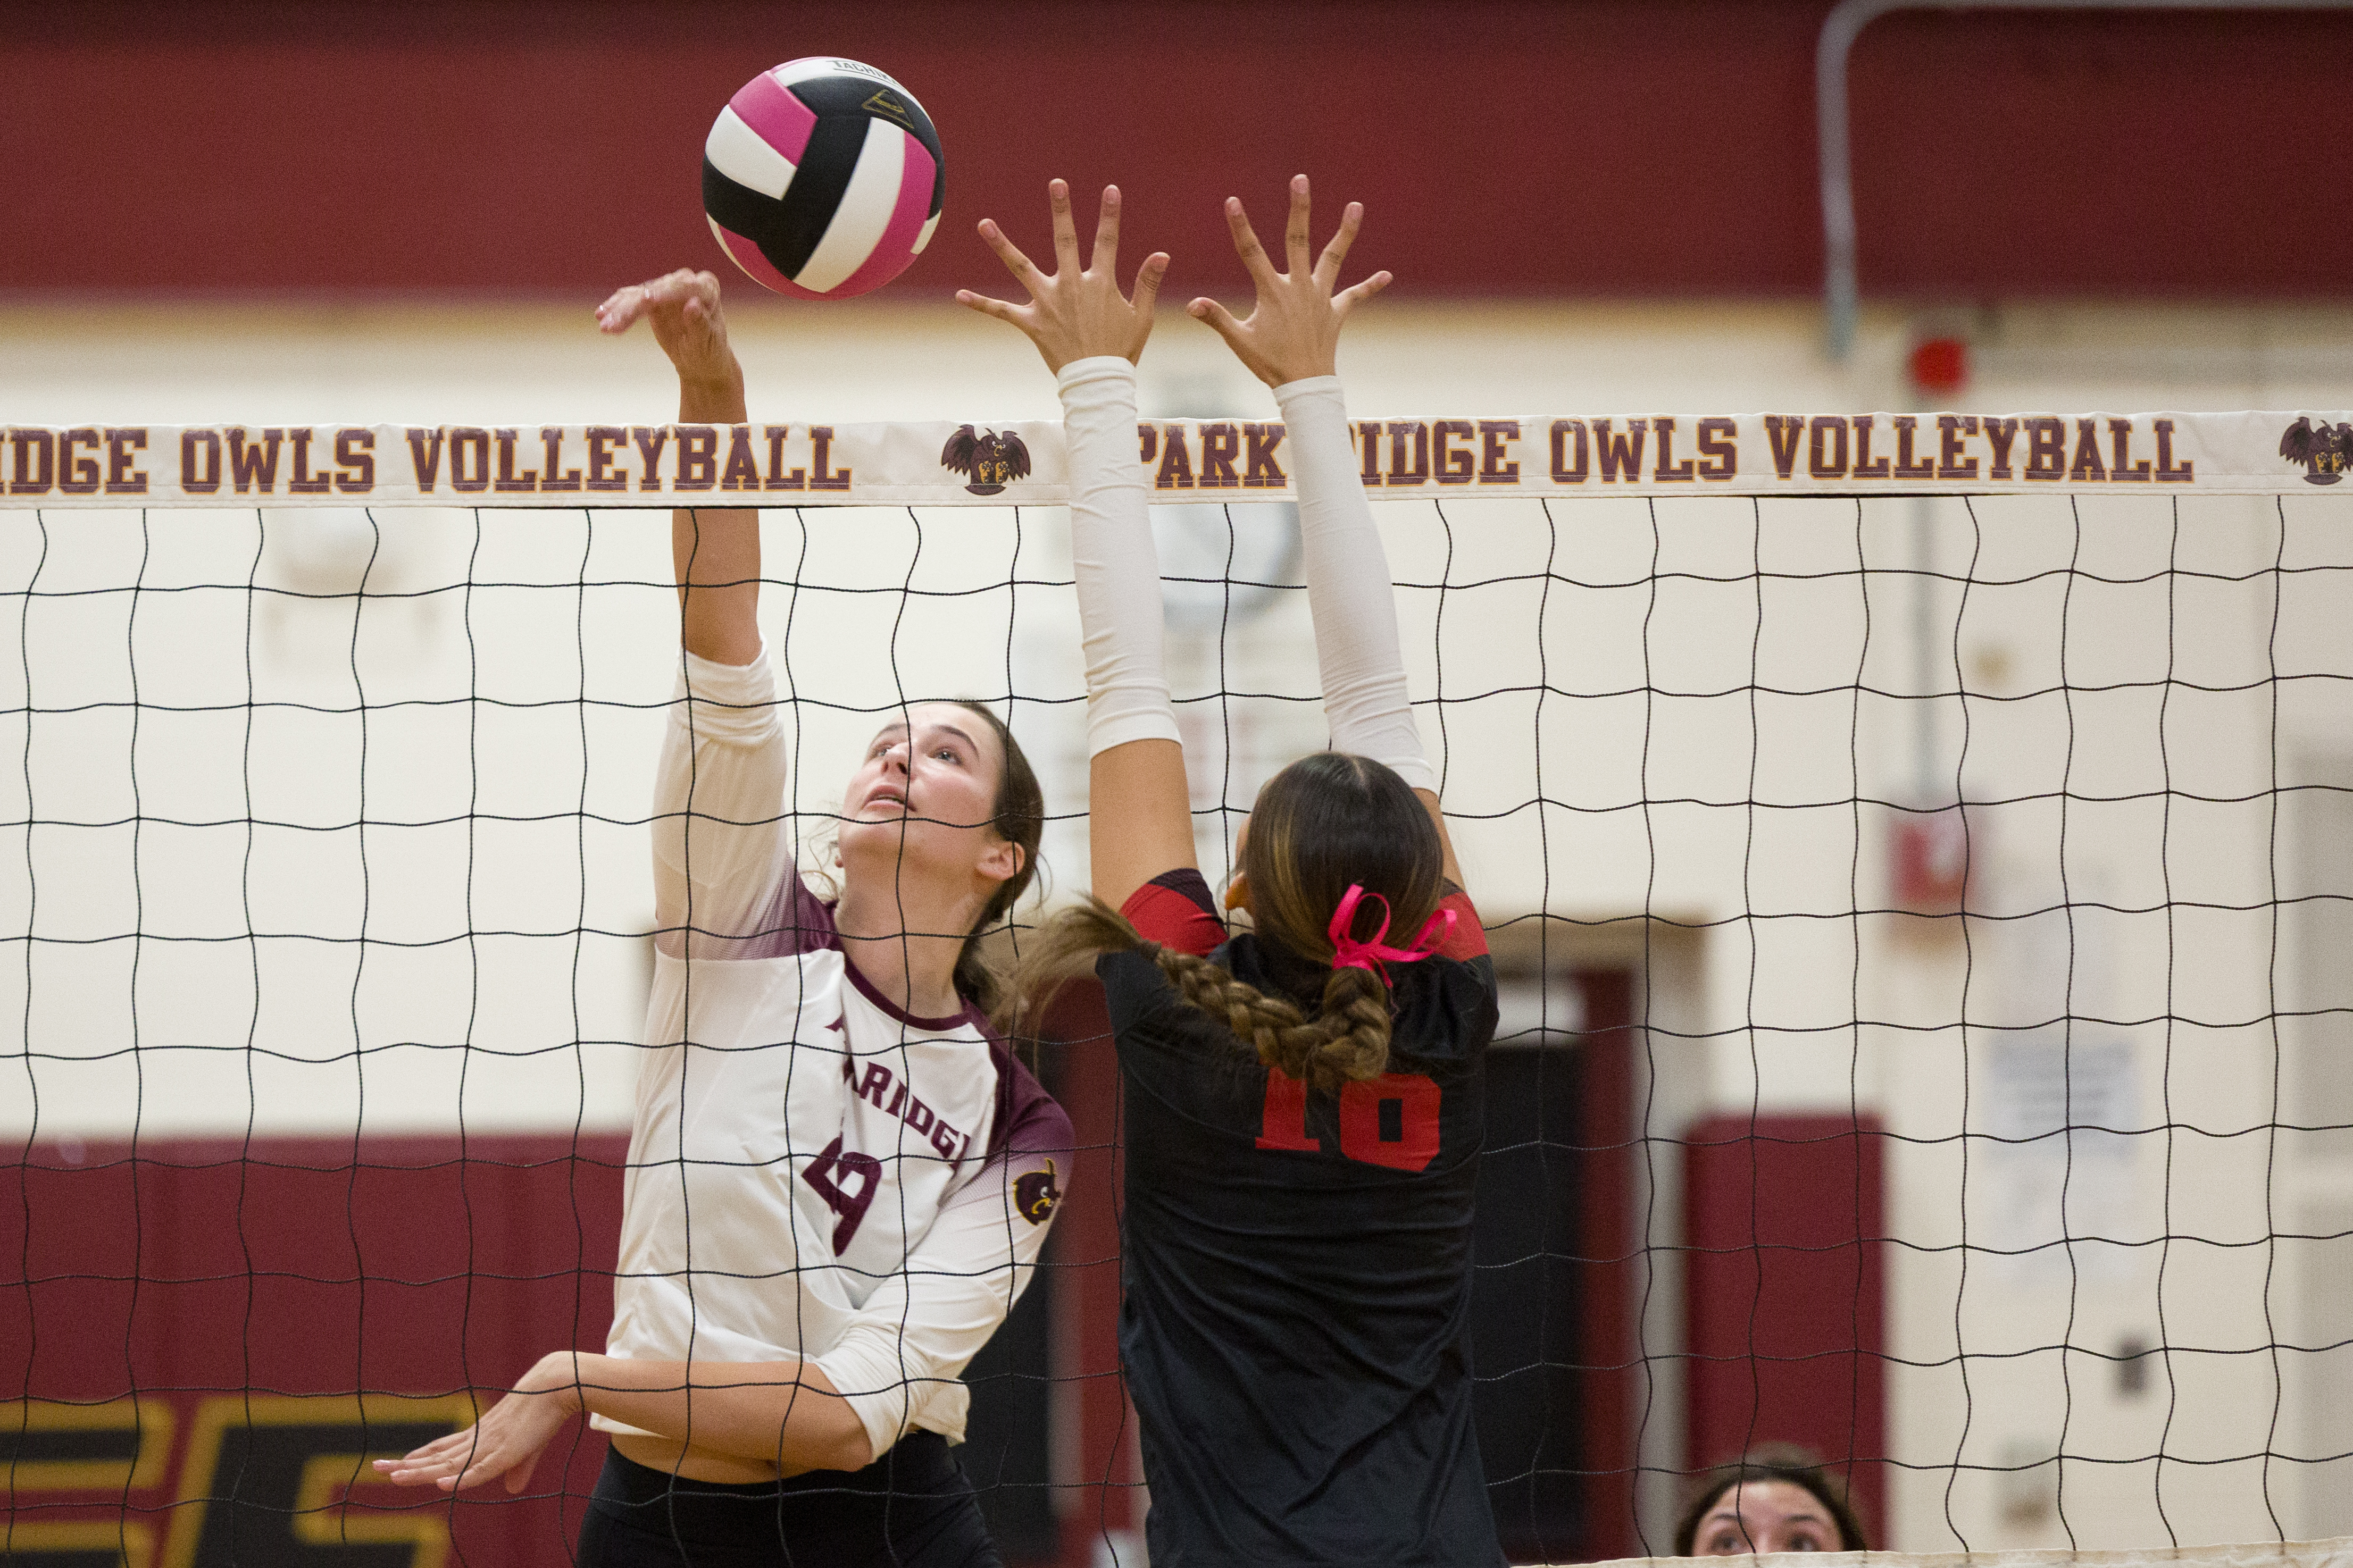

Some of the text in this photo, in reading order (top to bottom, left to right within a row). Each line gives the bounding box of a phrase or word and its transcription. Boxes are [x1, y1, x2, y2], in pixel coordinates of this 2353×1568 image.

[0, 426, 852, 496] DGE OWLS VOLLEYBALL
[1349, 419, 1521, 487] IDGE
[1549, 417, 1738, 485] OWLS
[1763, 415, 2195, 484] VOLLEYBALL
